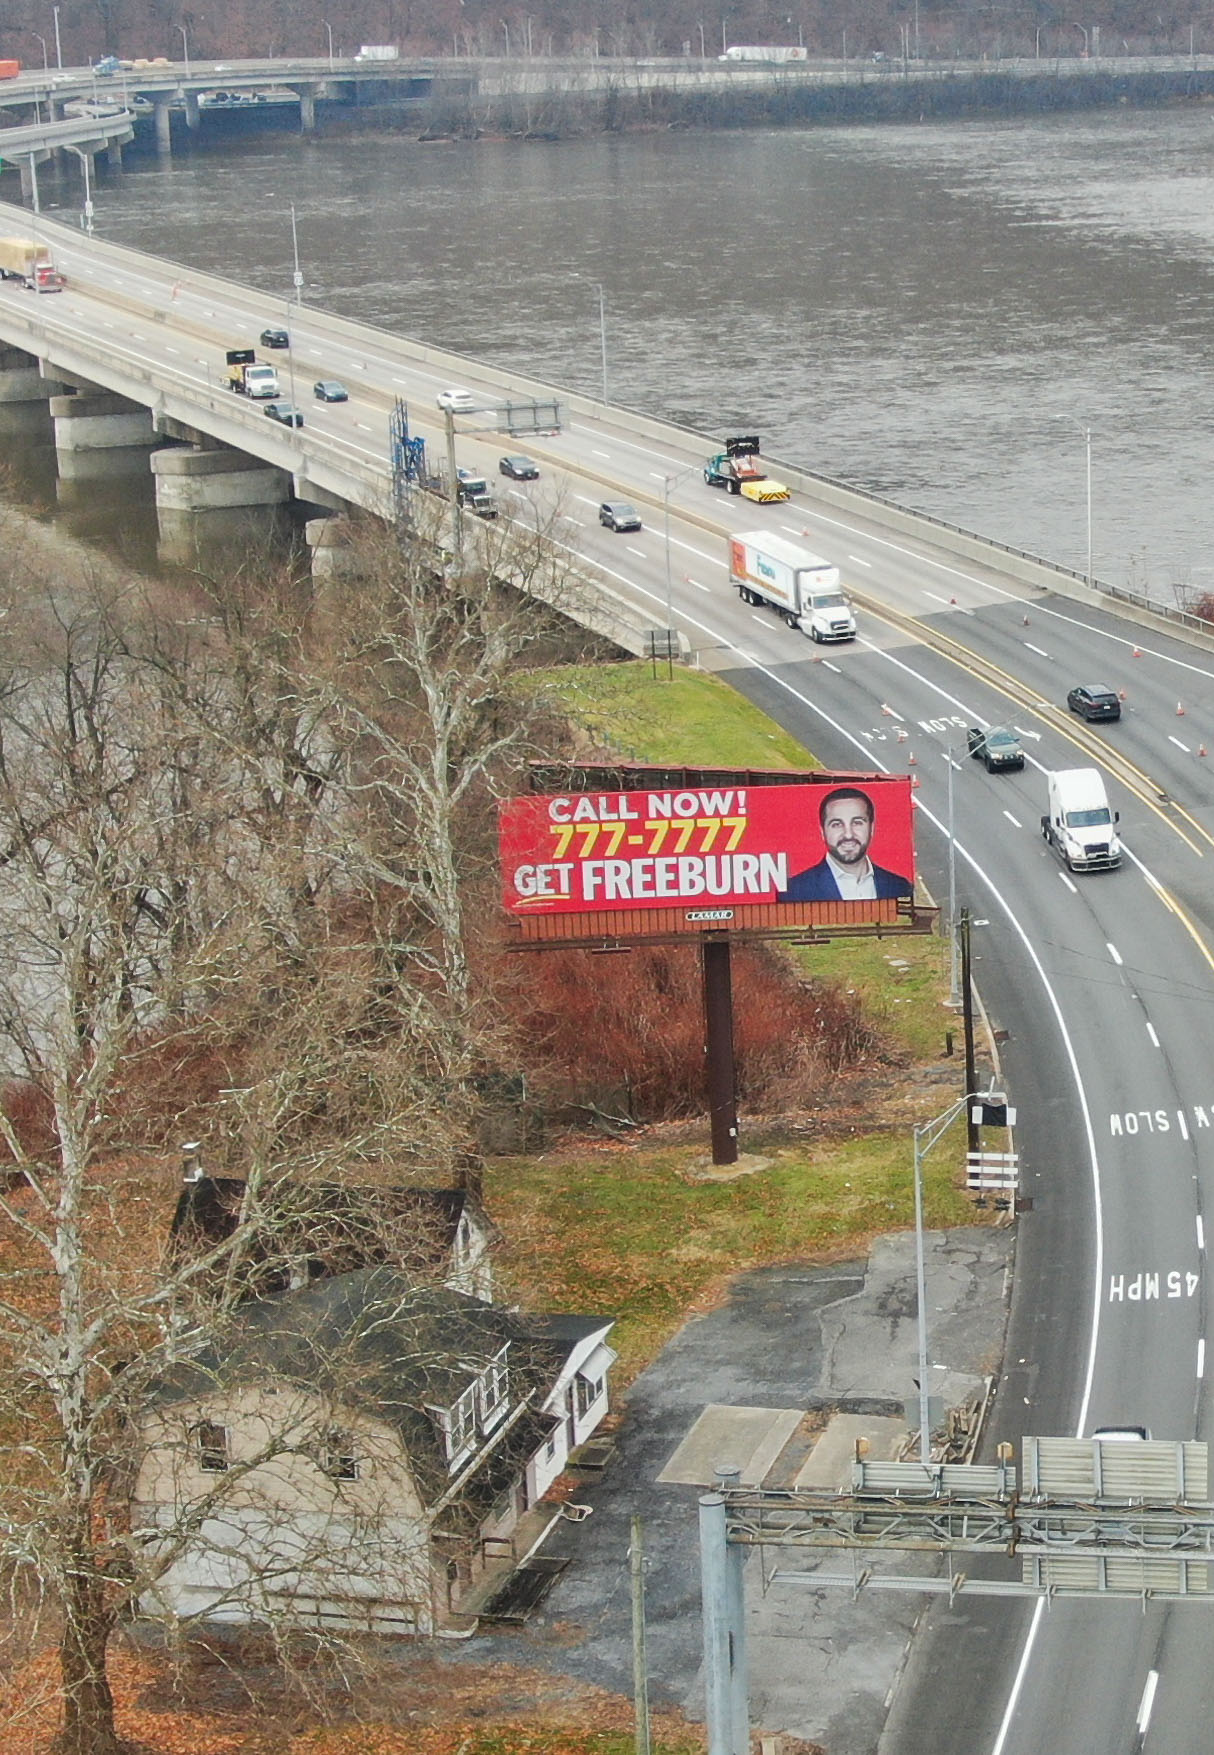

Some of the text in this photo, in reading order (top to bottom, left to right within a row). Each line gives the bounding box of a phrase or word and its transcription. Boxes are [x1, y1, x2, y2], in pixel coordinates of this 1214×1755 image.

[917, 716, 968, 734] SLOW
[548, 790, 748, 823] CALL NOW!
[549, 816, 748, 859] 777-7777
[513, 851, 788, 901] GET FREEBURN
[691, 910, 727, 920] LAMAR
[1109, 1110, 1170, 1136] SLOW
[1109, 1271, 1199, 1302] 45 MPH
